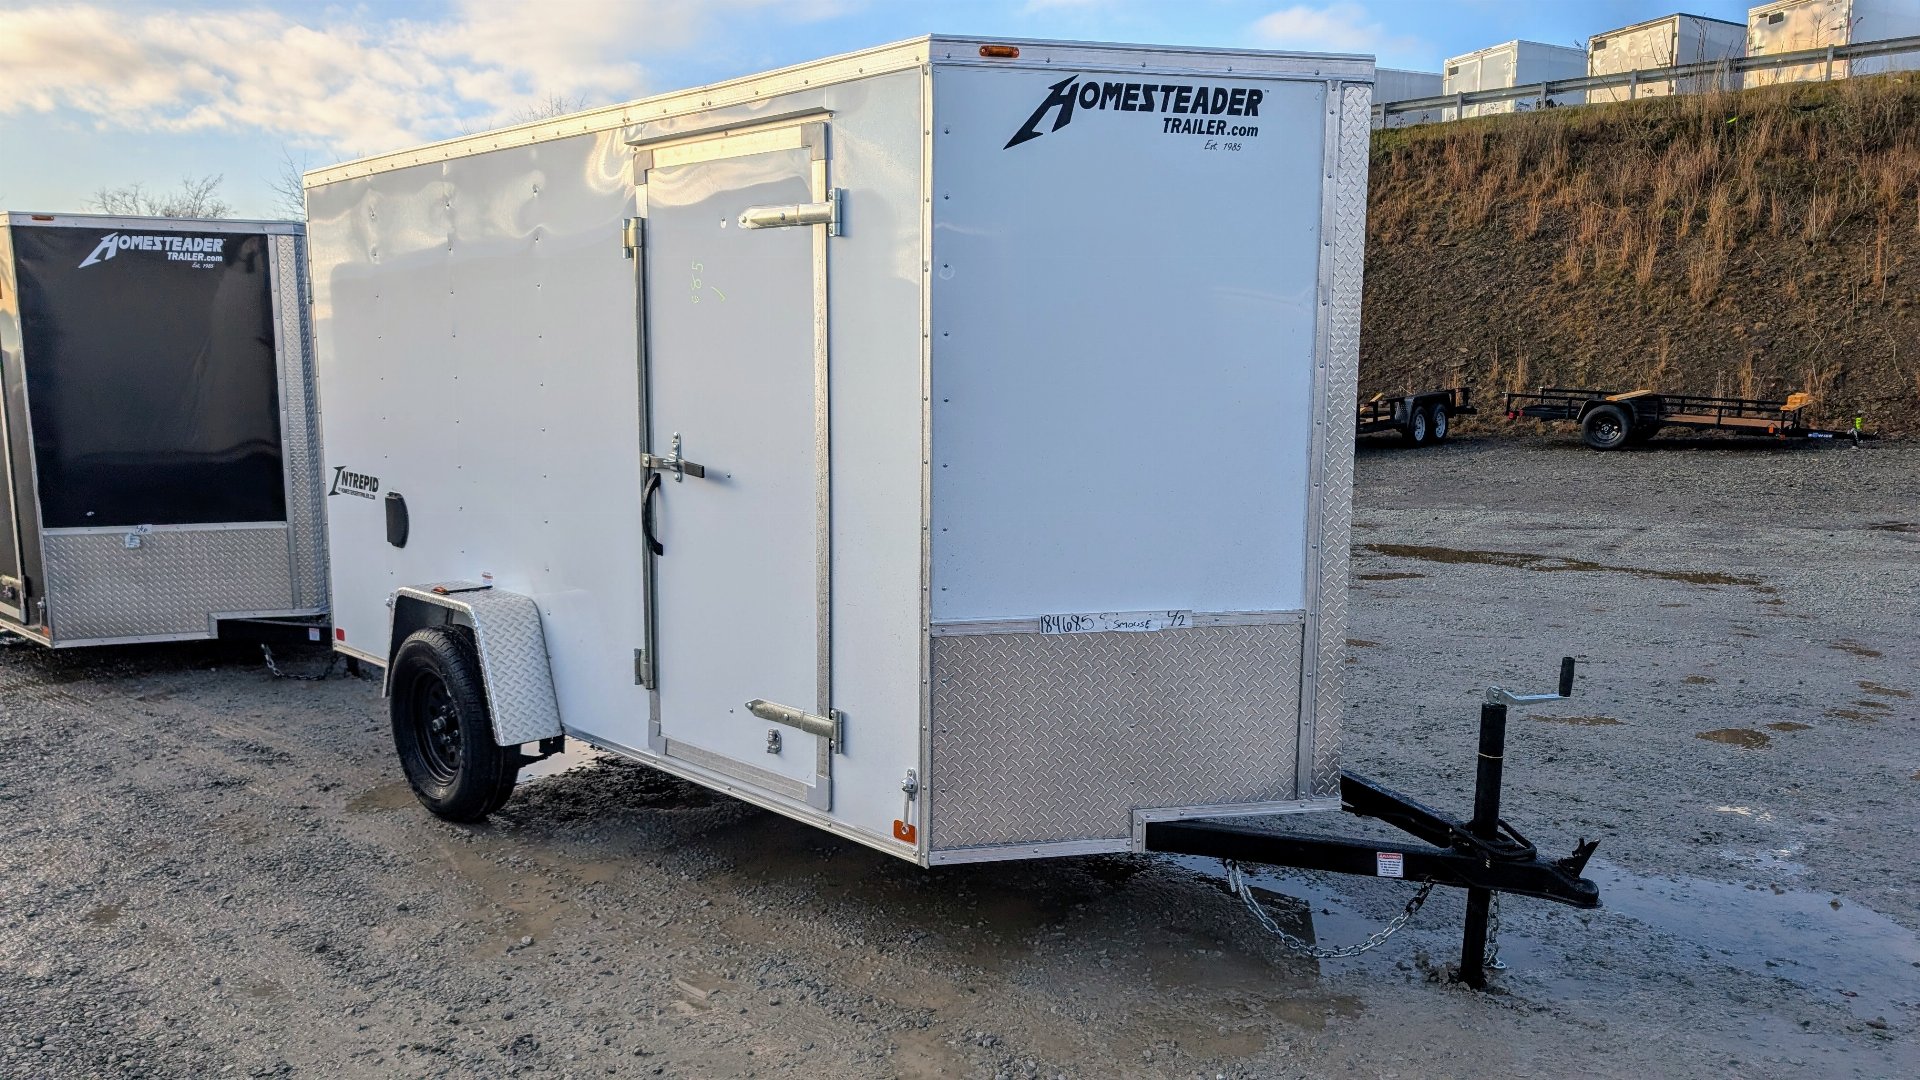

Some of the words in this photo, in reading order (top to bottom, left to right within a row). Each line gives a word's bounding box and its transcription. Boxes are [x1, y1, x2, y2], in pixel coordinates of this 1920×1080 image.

[1003, 74, 1264, 150] HOMESTEADER
[1163, 117, 1259, 137] TRAILER.com
[1223, 142, 1242, 151] 1985
[78, 232, 224, 268] HOMESTEADER
[167, 252, 223, 262] TRAILER.com
[328, 465, 380, 496] INTREPID
[1040, 614, 1095, 633] 184685
